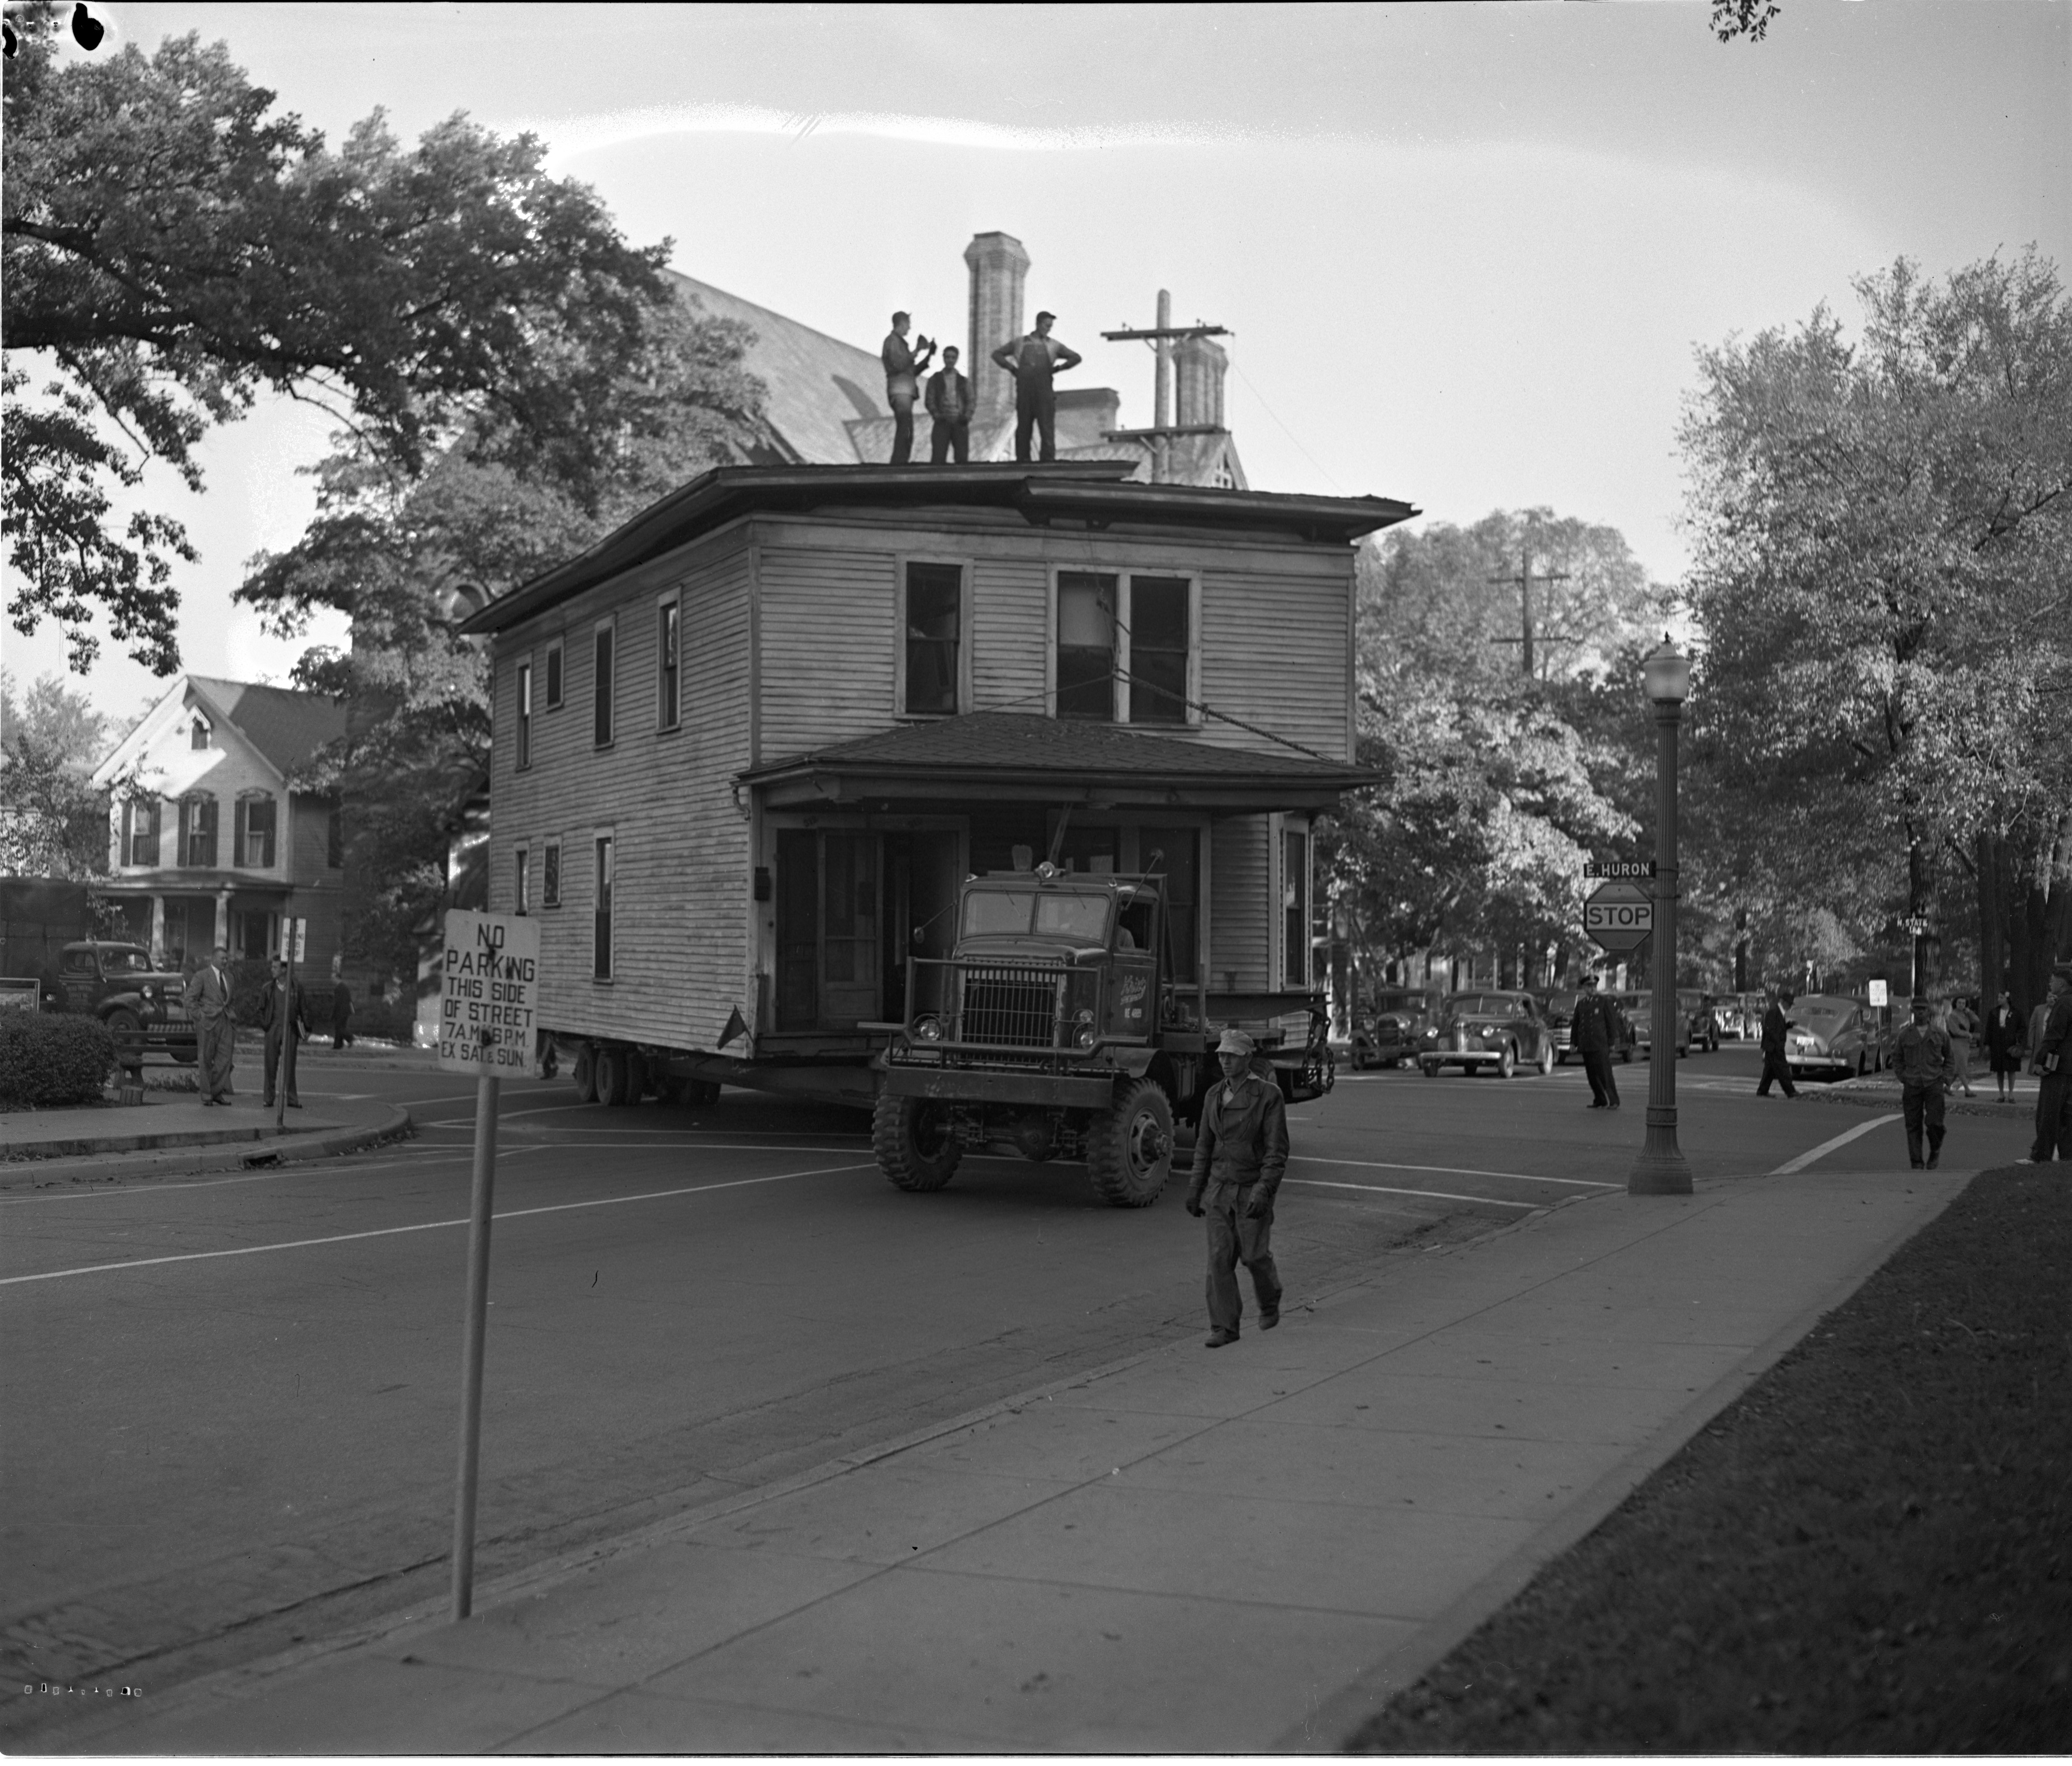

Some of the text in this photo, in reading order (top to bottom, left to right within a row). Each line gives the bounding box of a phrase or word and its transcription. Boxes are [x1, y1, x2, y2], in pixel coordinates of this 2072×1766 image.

[1586, 863, 1649, 877] E. HURON
[1589, 907, 1650, 926] STOP
[1905, 918, 1928, 927] STATE
[478, 923, 505, 949] NO
[447, 950, 535, 982] PARKING
[448, 977, 526, 1004] THIS SIDE
[444, 999, 534, 1028] OF STREET
[442, 1041, 455, 1059] EX
[487, 1051, 494, 1064] &
